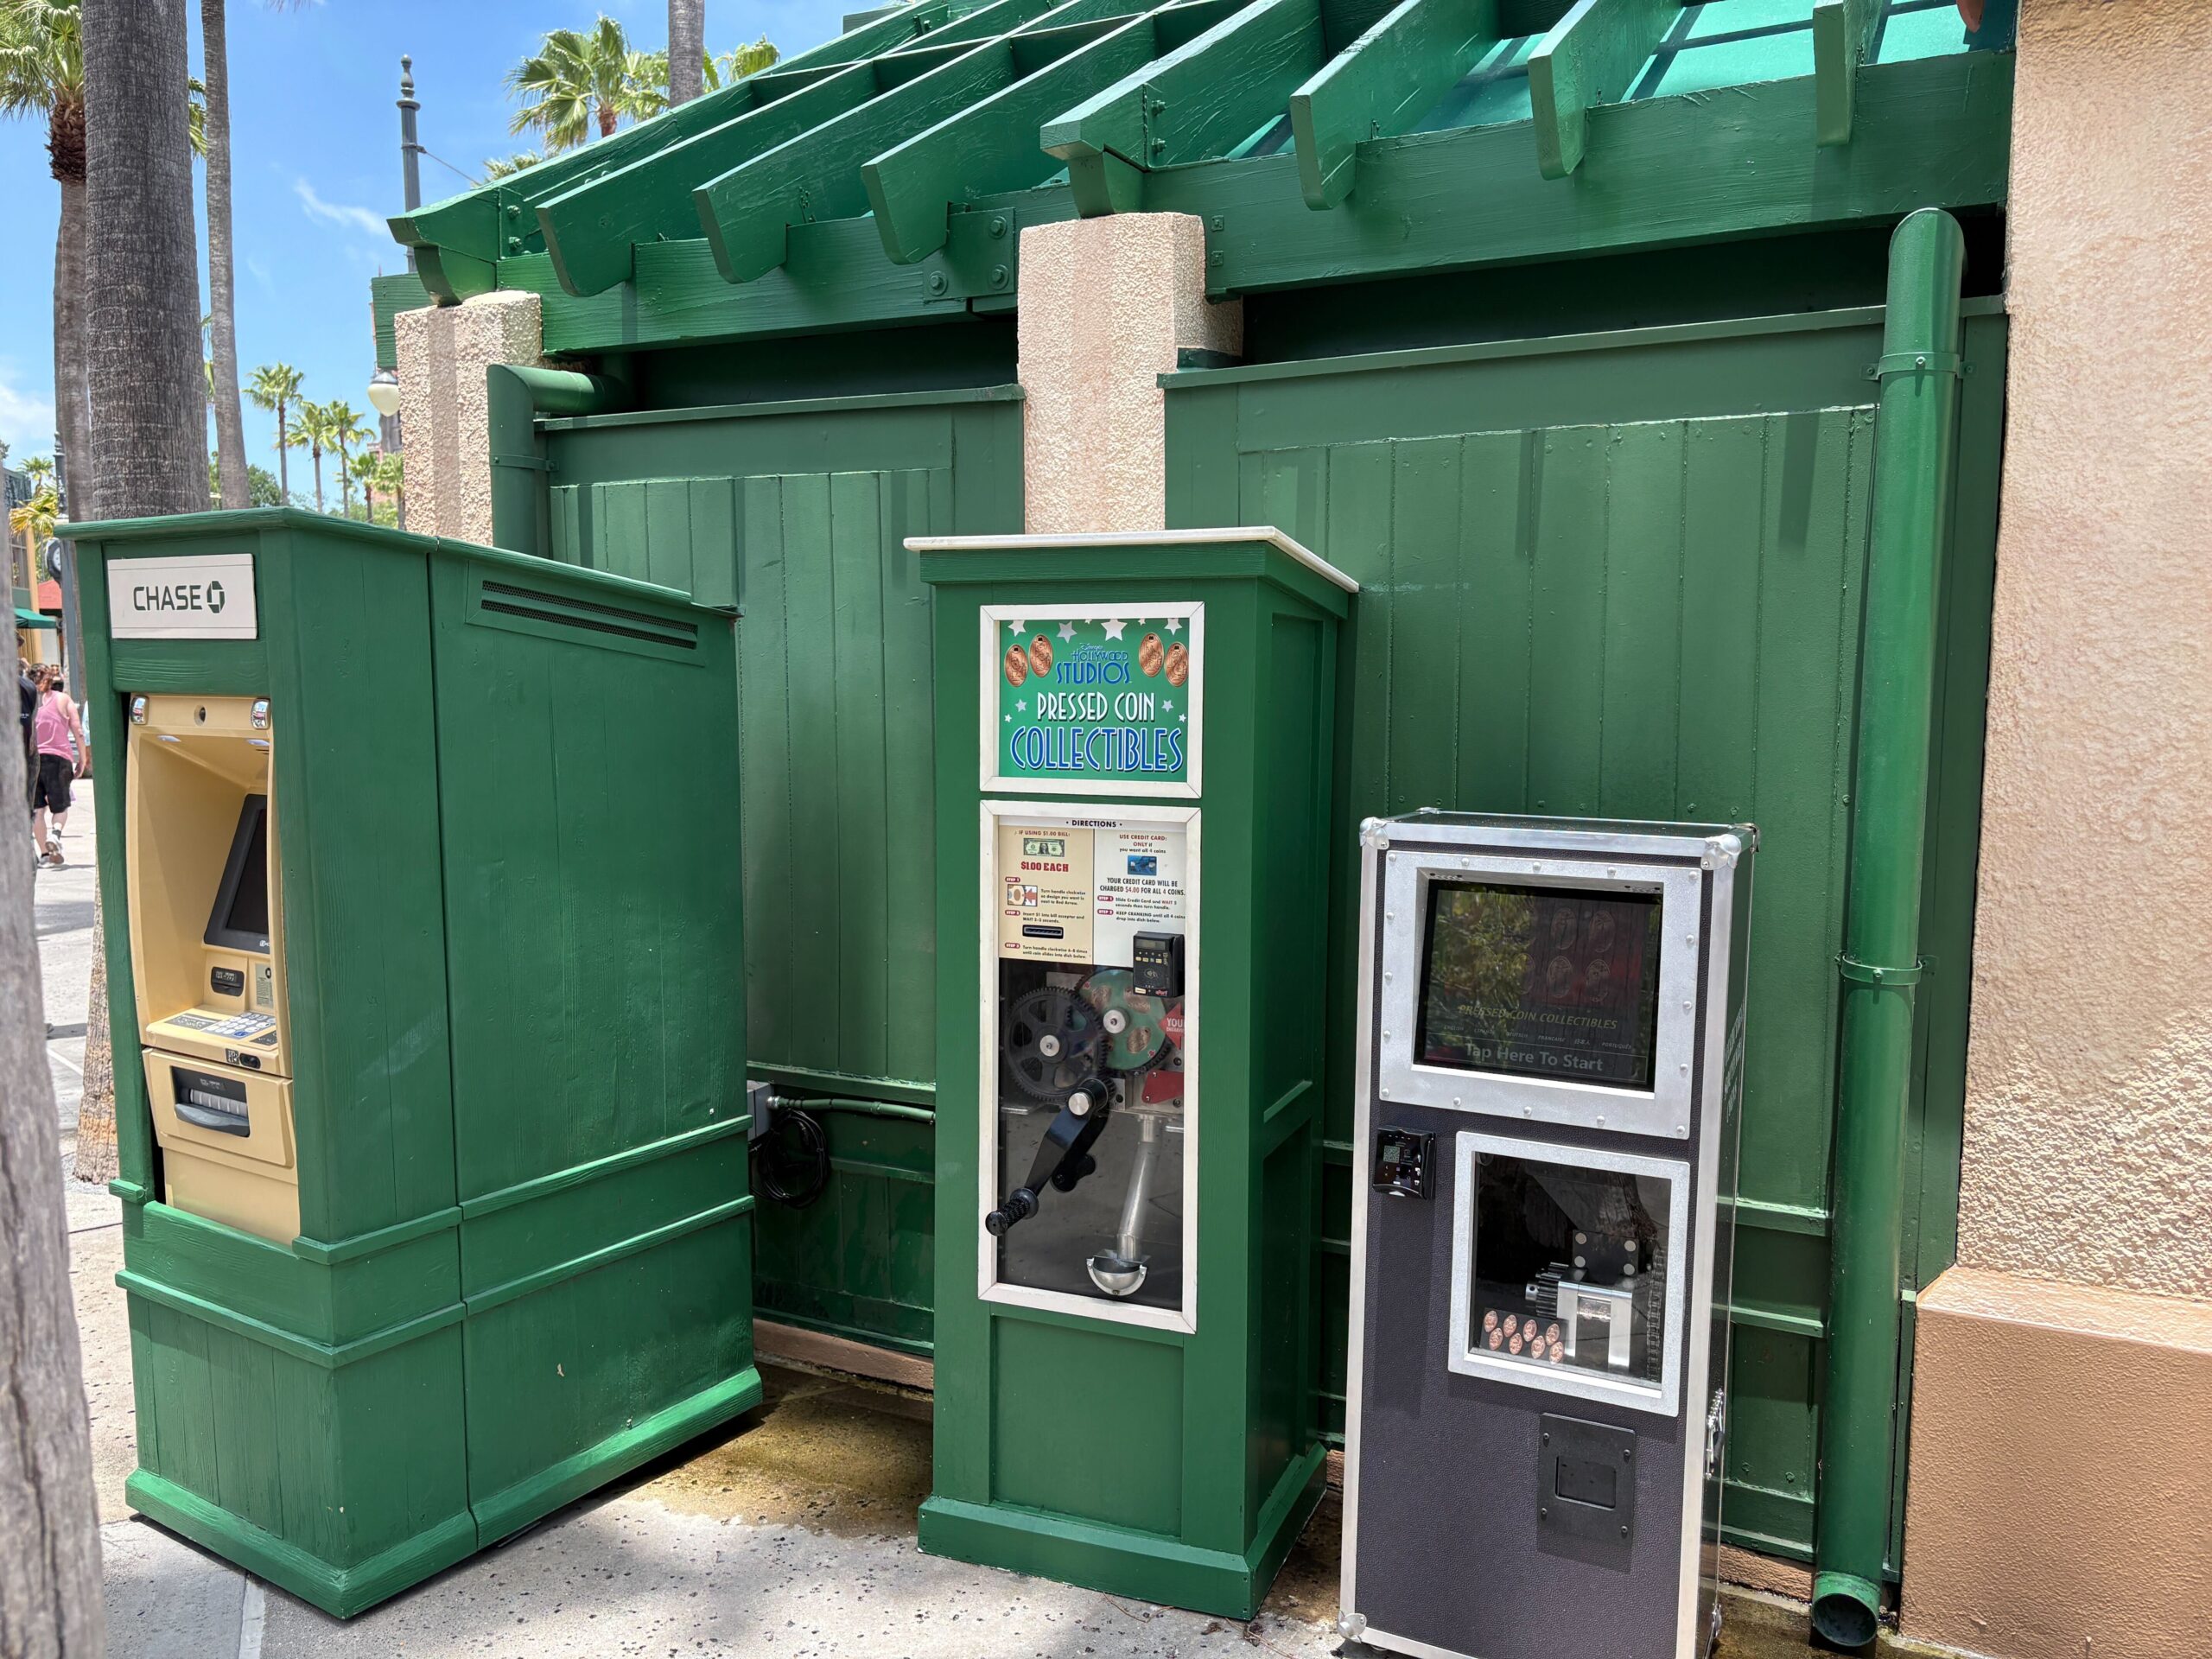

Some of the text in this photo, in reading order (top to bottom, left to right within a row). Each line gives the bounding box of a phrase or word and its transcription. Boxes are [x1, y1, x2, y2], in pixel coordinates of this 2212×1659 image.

[133, 585, 202, 610] CHASE
[1071, 649, 1128, 661] HOLLYWOOD
[1056, 662, 1130, 684] STUDIOS
[1038, 692, 1155, 722] PRESSED COIN
[1010, 726, 1183, 772] COLLECTIBLES
[1021, 861, 1069, 872] $1.00 EACH
[1166, 1018, 1185, 1027] YOU
[1458, 1004, 1618, 1030] PRESSED COIN COLLECTIBLES
[1465, 1043, 1604, 1071] Tap Here To Start
